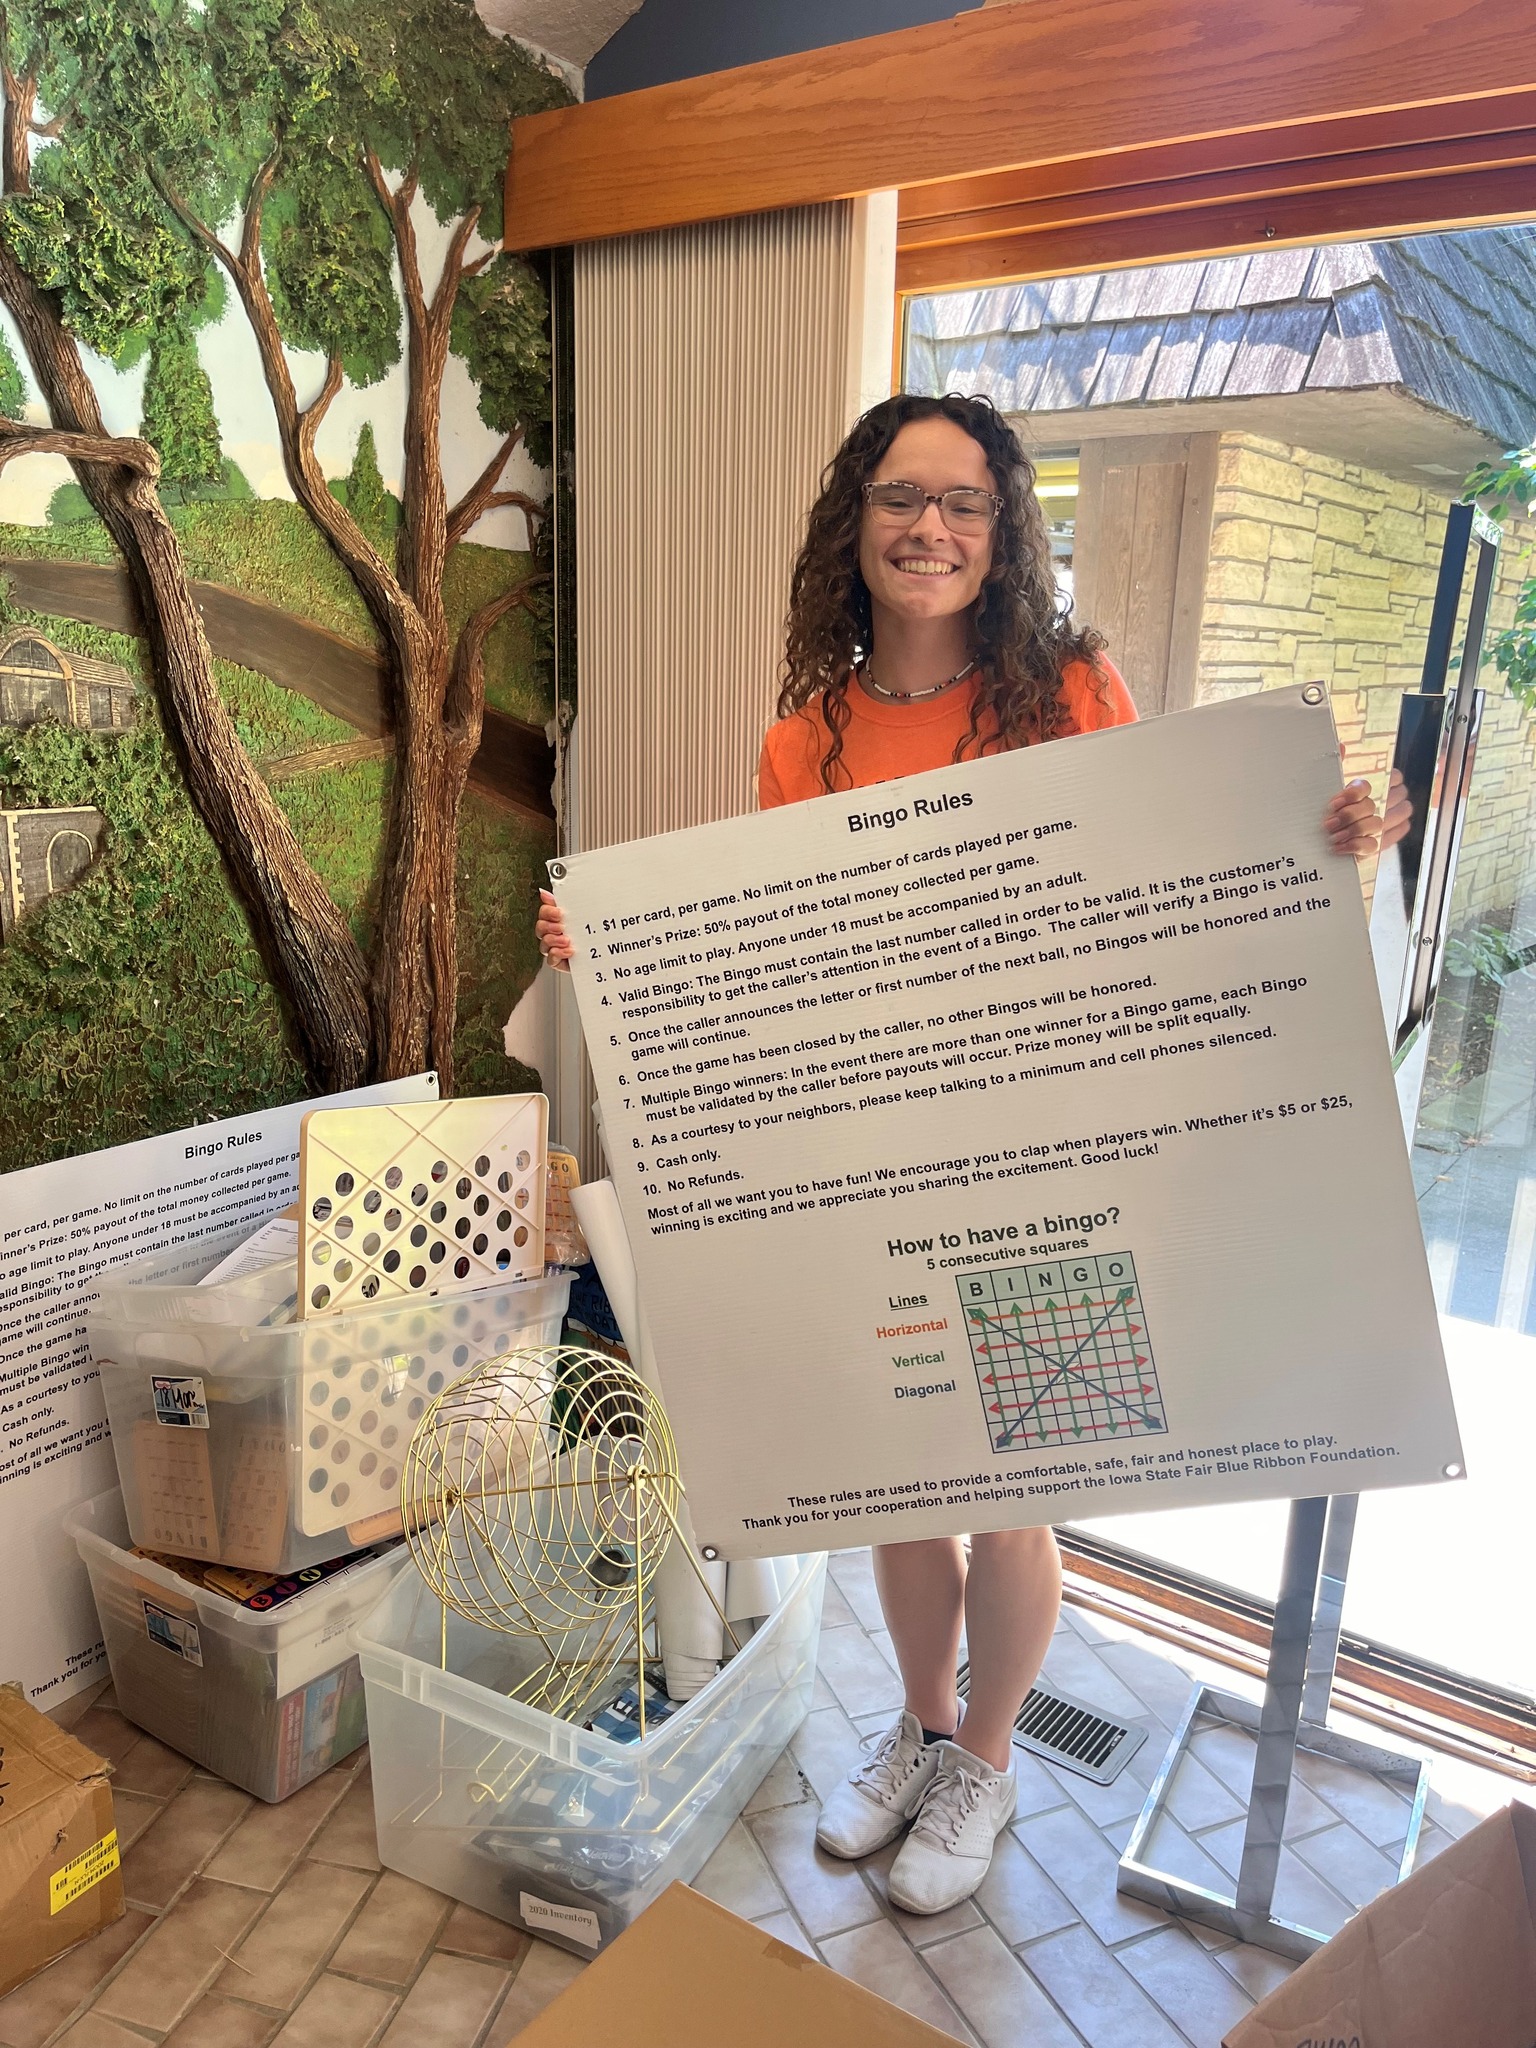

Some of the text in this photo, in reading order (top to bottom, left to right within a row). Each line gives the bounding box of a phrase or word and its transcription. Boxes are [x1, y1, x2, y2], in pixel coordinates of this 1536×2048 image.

[847, 792, 973, 832] Bingo Rules
[585, 820, 1077, 934] 1. $1 per card, per game. No limit on the number of cards played per game.
[589, 947, 602, 959] 2.
[664, 927, 701, 943] Prize:
[704, 919, 731, 935] 50%
[734, 909, 779, 931] payout
[781, 904, 794, 918] of
[796, 902, 818, 914] the
[820, 892, 851, 909] total
[854, 884, 899, 903] money
[903, 868, 966, 892] collected
[969, 864, 992, 881] per
[996, 856, 1039, 875] game.
[595, 871, 1087, 982] 3. No age limit to play. Anyone under 18 must be accompanied by an adult.
[631, 1028, 750, 1061] game will continue.
[185, 1131, 262, 1159] Bingo Rules
[637, 1149, 721, 1172] 9. Cash only.
[4, 1154, 289, 1241] per card, per game. No limit on the number of cards played per
[643, 1170, 744, 1195] 10. No Refunds.
[38, 1171, 291, 1249] Prize: 50% payout of the total money collected per game.
[887, 1206, 1120, 1257] How to have a bingo?
[927, 1238, 1089, 1270] 5 consecutive squares
[970, 1262, 1124, 1297] B I N G O
[888, 1294, 927, 1308] Lines
[25, 1308, 91, 1335] will continue.
[876, 1317, 948, 1338] Horizontal
[891, 1350, 945, 1368] Vertical
[0, 1377, 80, 1415] As a courtesy to
[894, 1379, 956, 1398] Diagonal
[2, 1406, 54, 1432] Cash only.
[9, 1419, 69, 1449] No Refunds.
[741, 1446, 1400, 1529] Thank you for your cooperation and helping support the Iowa State Fair Blue Ribbon Foundation.
[787, 1435, 1337, 1508] These rules are used to provide a comfortable, safe, fair and honest place to play.
[65, 1647, 92, 1666] These
[30, 1657, 93, 1697] Thank you for
[528, 1904, 592, 1927] 2020 Inventory
